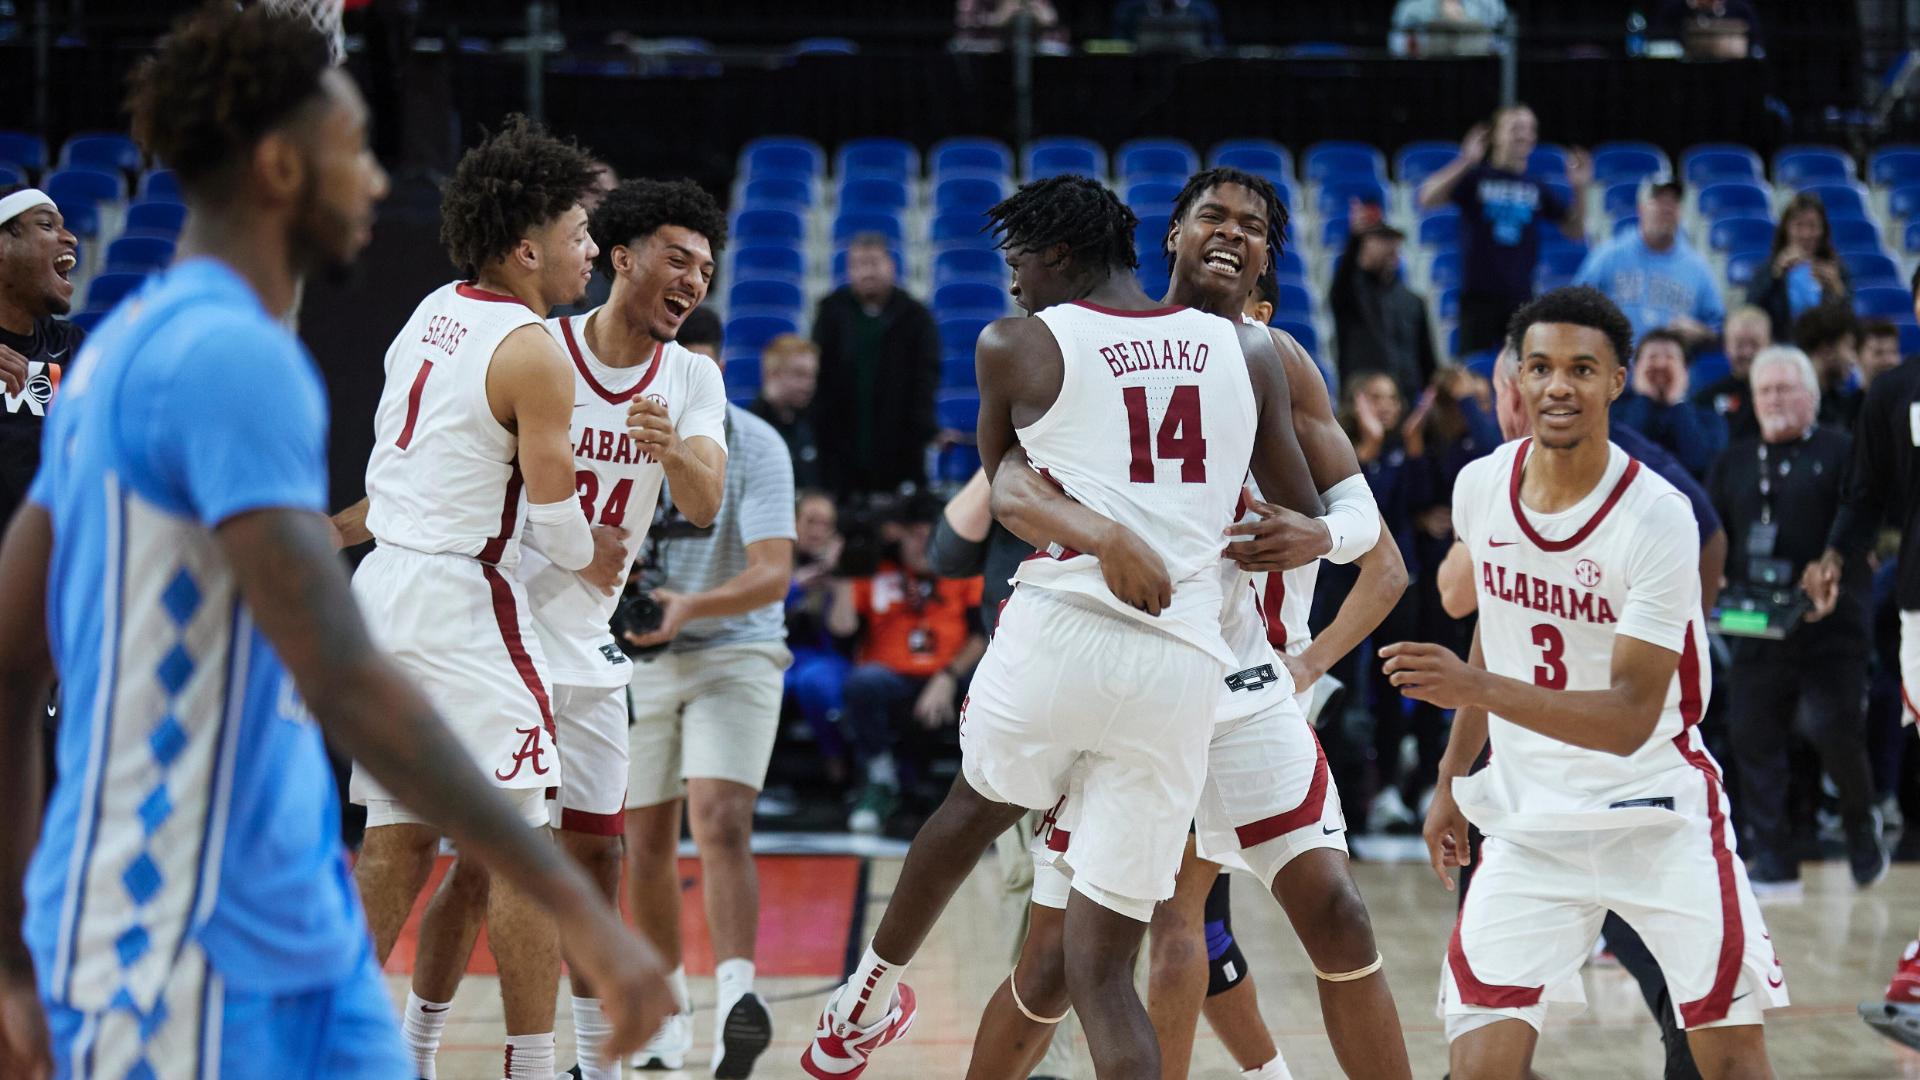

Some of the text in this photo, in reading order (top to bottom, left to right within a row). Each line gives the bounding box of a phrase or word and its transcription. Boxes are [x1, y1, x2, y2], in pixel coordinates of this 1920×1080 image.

[421, 315, 467, 356] SEARS
[1099, 340, 1209, 378] BEDIAKO
[395, 359, 434, 451] 1
[1122, 385, 1207, 483] 14
[575, 470, 634, 528] 34
[1483, 561, 1618, 625] ALABAMA
[1531, 623, 1568, 691] 3
[495, 725, 550, 781] A
